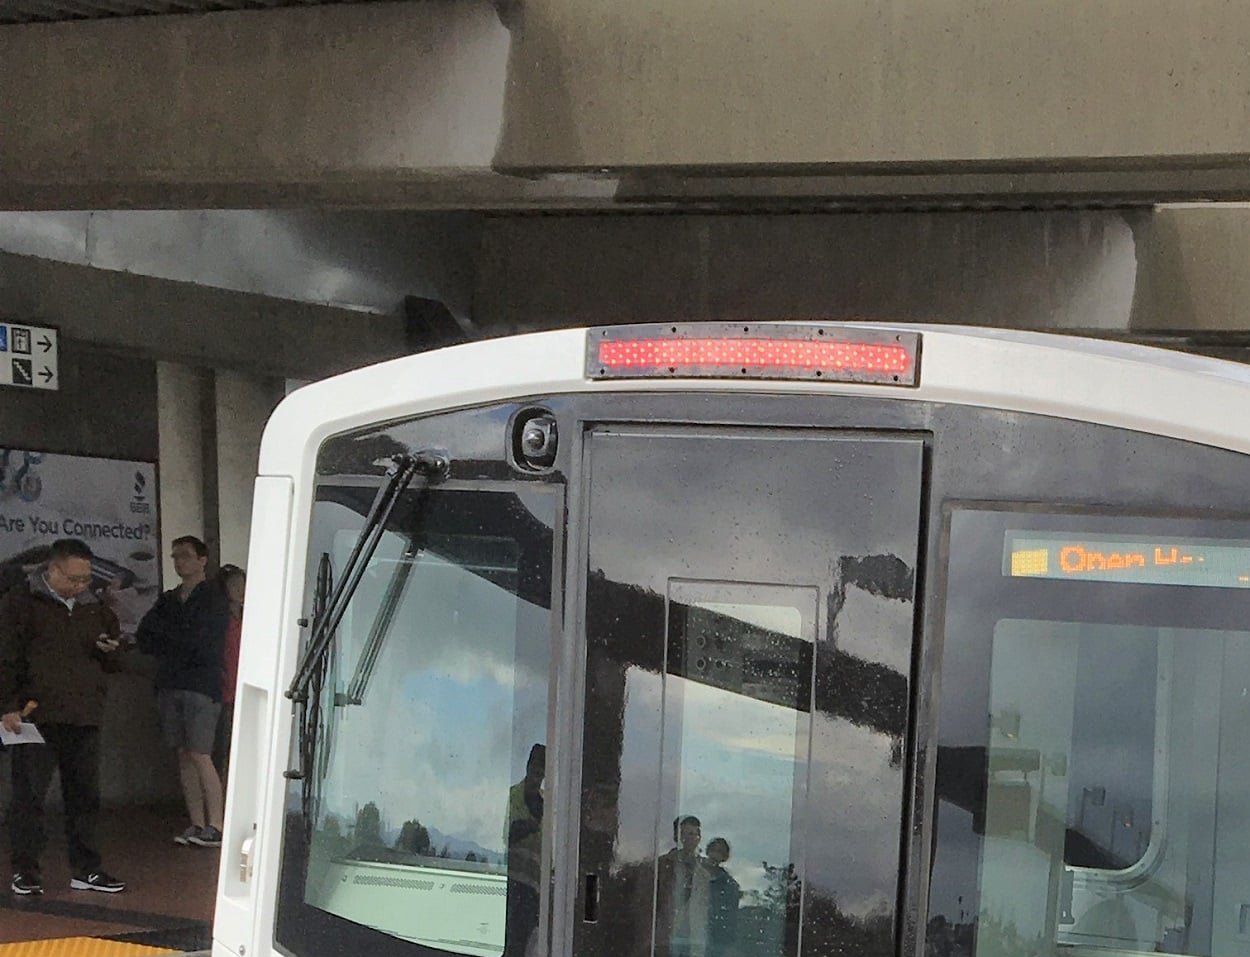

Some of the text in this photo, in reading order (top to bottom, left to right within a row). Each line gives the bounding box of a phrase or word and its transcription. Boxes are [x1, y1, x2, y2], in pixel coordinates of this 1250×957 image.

[0, 514, 151, 540] Are You Connected?
